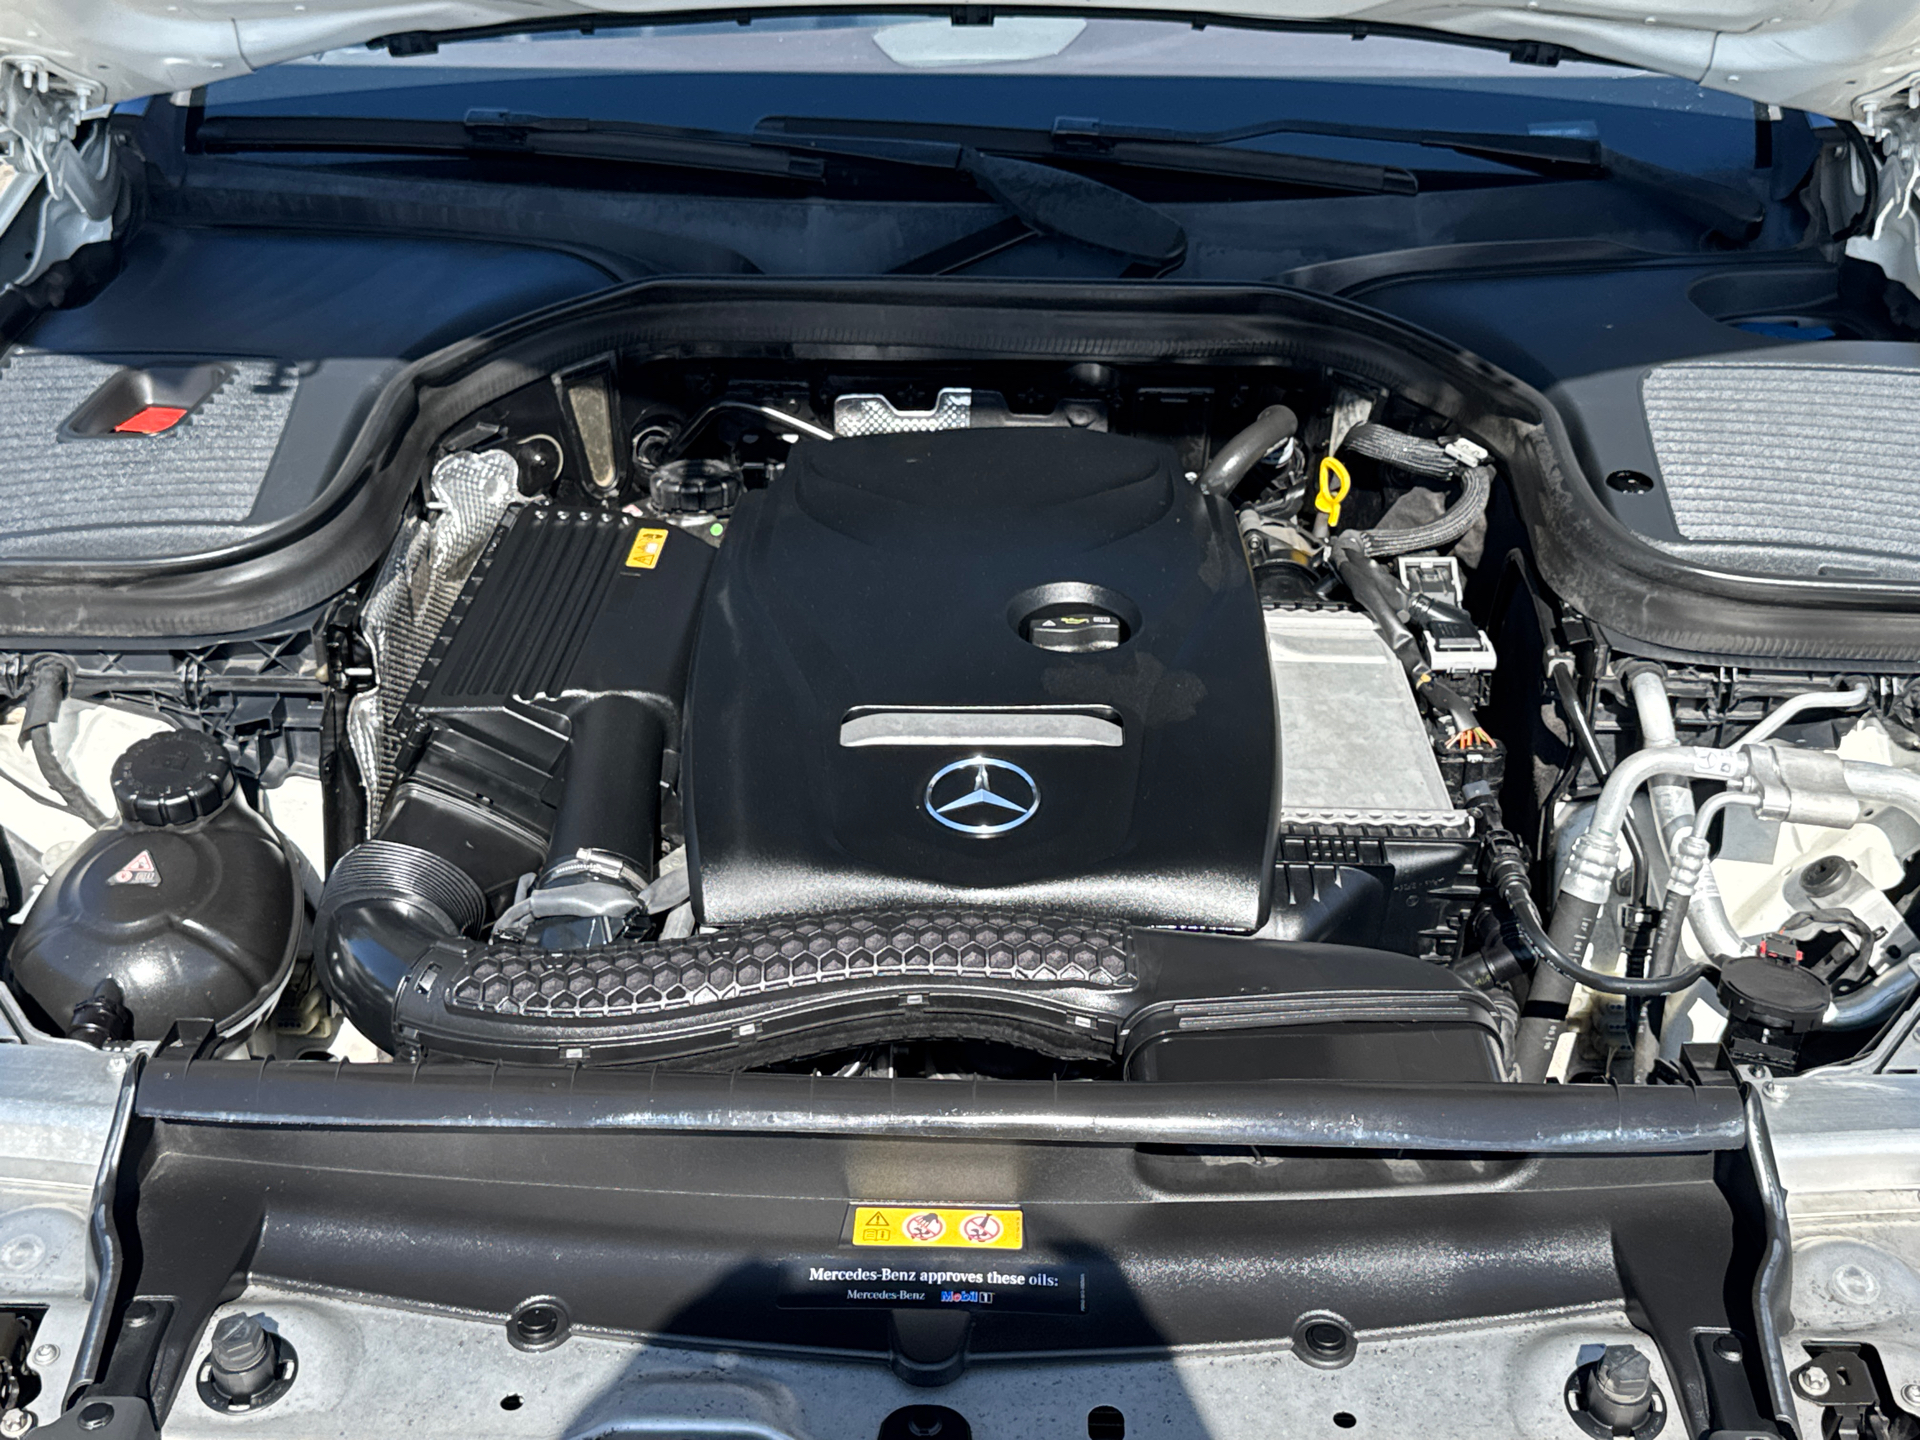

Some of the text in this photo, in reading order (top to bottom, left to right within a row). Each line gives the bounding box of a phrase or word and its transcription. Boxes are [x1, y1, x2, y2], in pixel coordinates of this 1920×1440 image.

[809, 1267, 1059, 1287] Mercedes-Benz approves these oils:
[846, 1289, 926, 1300] Mercedes-Benz
[941, 1290, 978, 1302] Mobil
